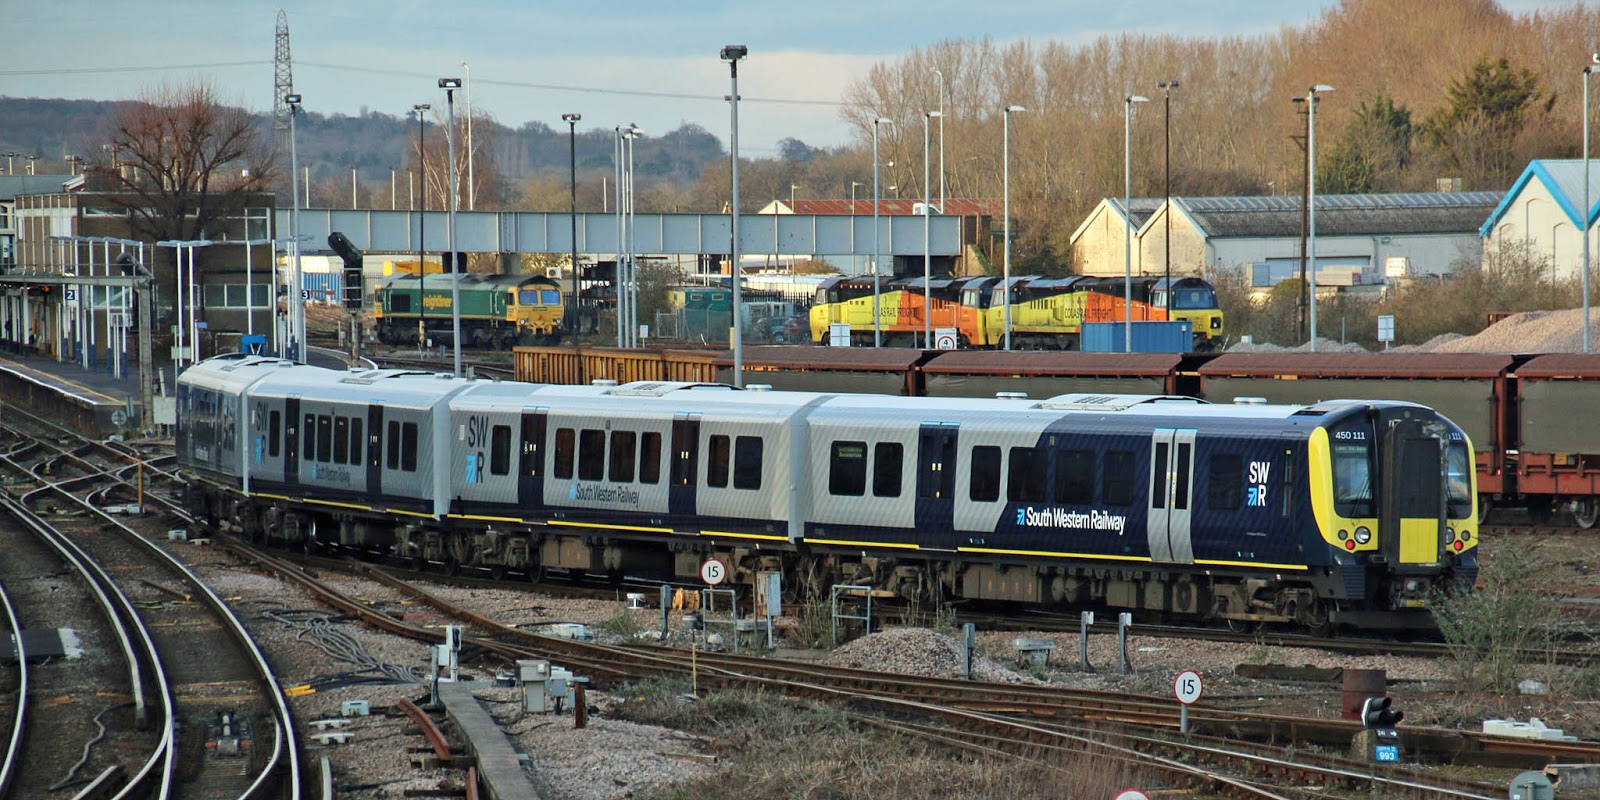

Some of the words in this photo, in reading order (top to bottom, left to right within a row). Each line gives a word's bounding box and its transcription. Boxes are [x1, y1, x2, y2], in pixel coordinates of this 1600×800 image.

[67, 290, 74, 300] 2
[302, 290, 309, 299] 3
[468, 414, 489, 448] SW
[1335, 431, 1351, 440] 450
[1353, 431, 1365, 440] 111
[476, 451, 485, 484] R
[1249, 461, 1271, 484] SW
[576, 482, 594, 500] South
[594, 484, 617, 502] Western
[618, 485, 640, 508] Railway
[1257, 484, 1267, 507] R
[1026, 506, 1052, 528] South
[1053, 508, 1090, 530] Western
[1090, 509, 1126, 536] Railway
[708, 565, 719, 578] 15
[1182, 679, 1195, 695] 15
[1379, 752, 1395, 760] 993
